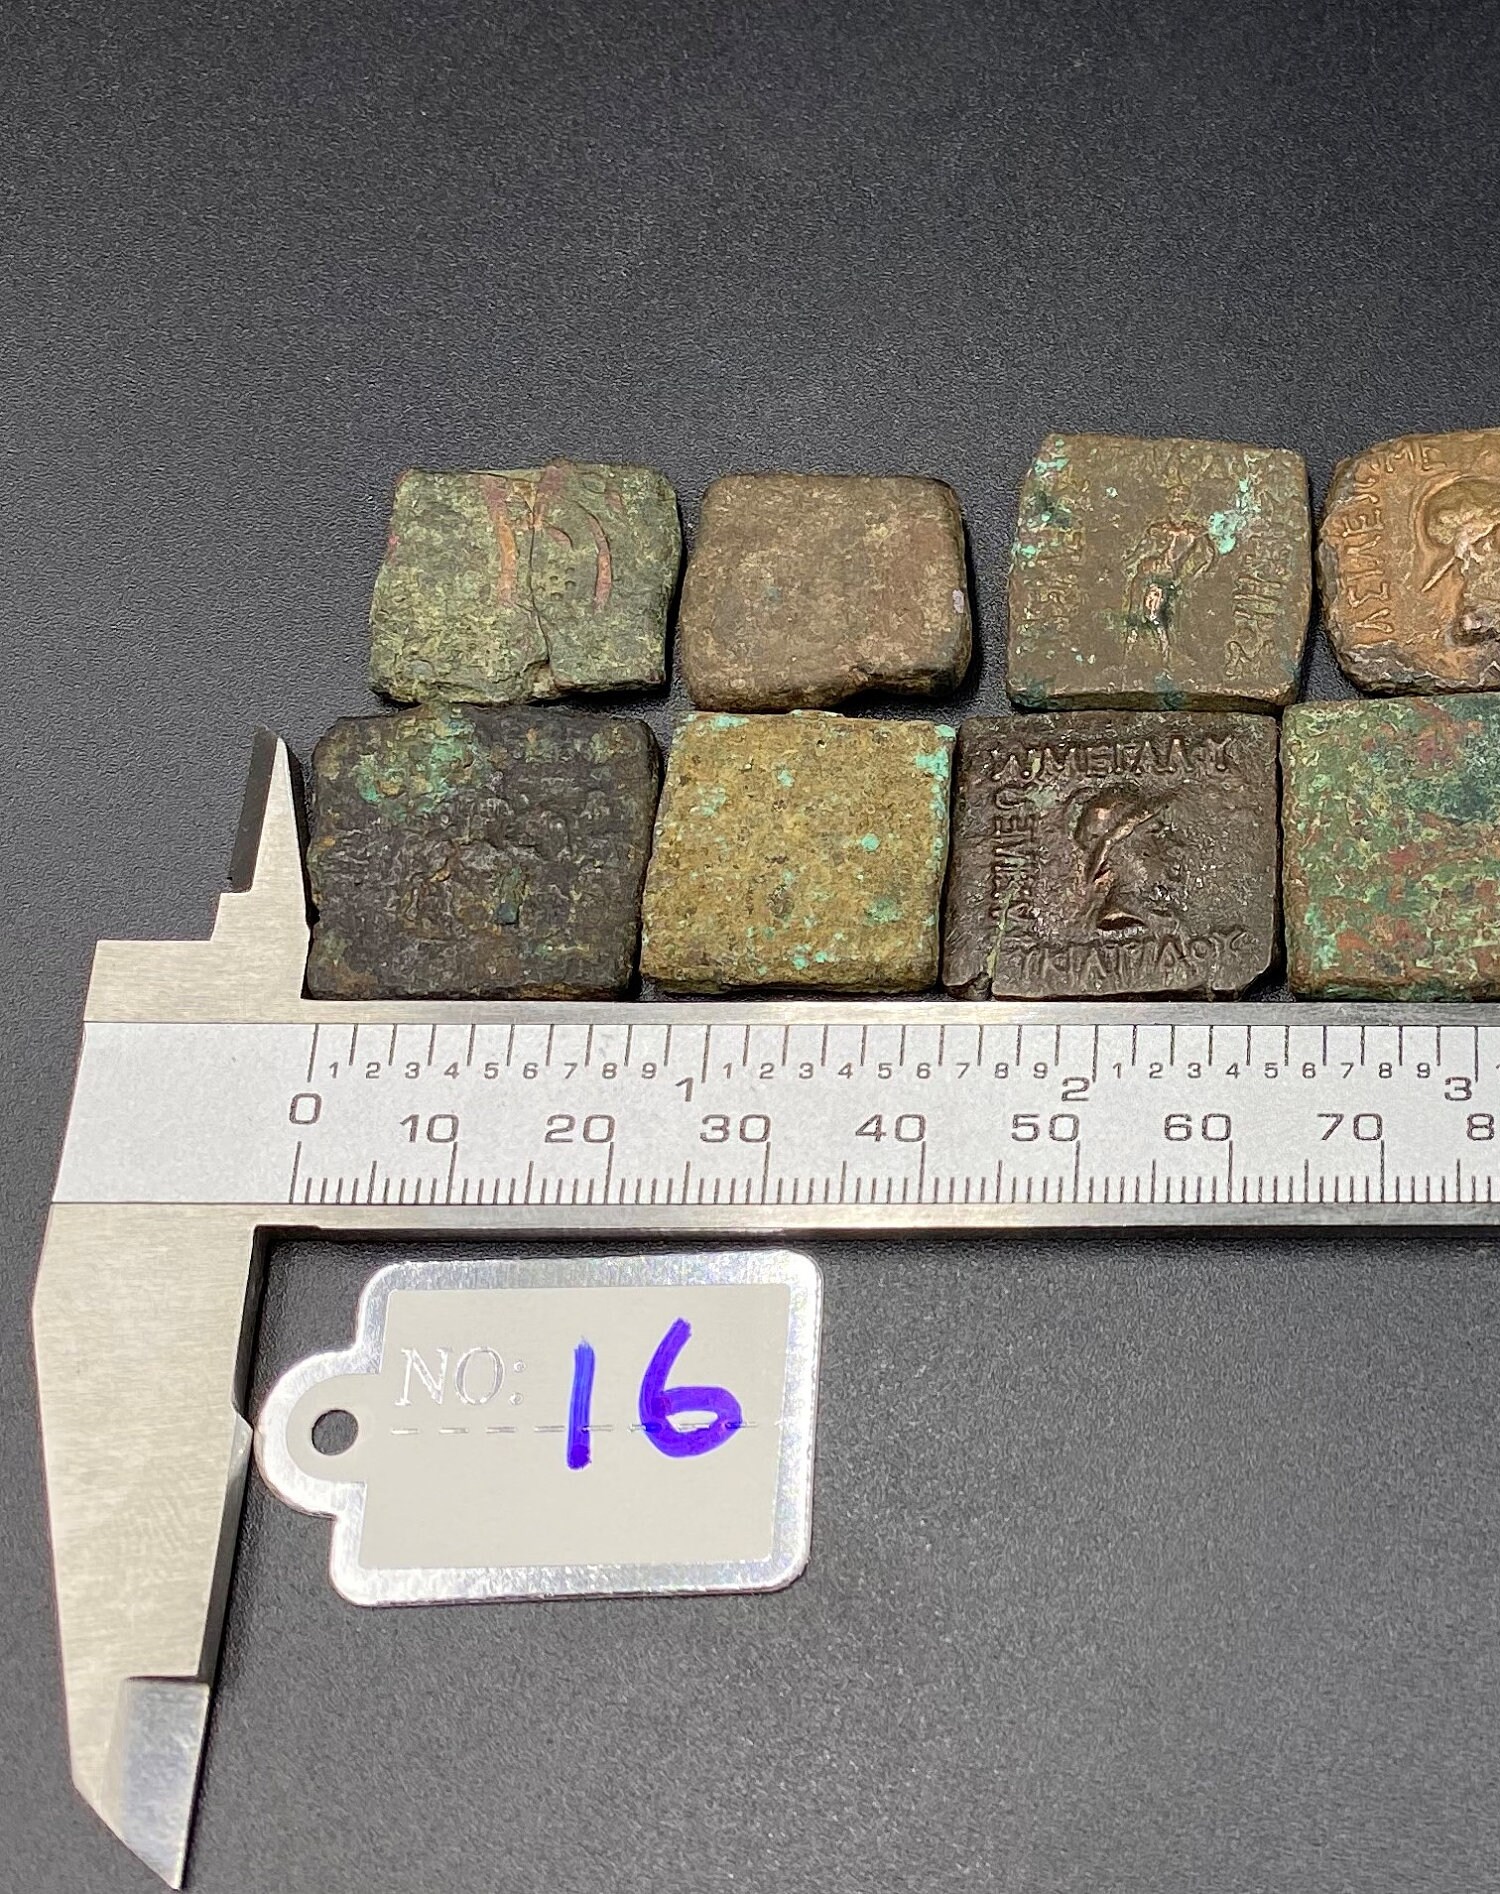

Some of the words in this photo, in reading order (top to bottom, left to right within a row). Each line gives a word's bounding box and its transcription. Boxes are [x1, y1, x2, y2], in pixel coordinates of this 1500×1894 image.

[328, 1060, 340, 1080] 1
[365, 1061, 382, 1080] 2
[404, 1061, 421, 1080] 3
[443, 1061, 461, 1080] 4
[483, 1061, 500, 1080] 5
[522, 1061, 539, 1080] 6
[562, 1061, 579, 1081] 7
[601, 1061, 618, 1080] 8
[640, 1061, 658, 1080] 9
[674, 1076, 695, 1103] 1
[722, 1061, 733, 1080] 1
[758, 1061, 776, 1080] 2
[798, 1061, 815, 1080] 3
[836, 1061, 854, 1080] 4
[877, 1061, 893, 1080] 5
[915, 1061, 932, 1080] 6
[954, 1061, 971, 1080] 7
[993, 1061, 1010, 1080] 8
[1032, 1061, 1049, 1080] 9
[1060, 1076, 1091, 1103] 2
[1112, 1061, 1123, 1080] 1
[1148, 1061, 1164, 1080] 2
[1186, 1061, 1202, 1080] 3
[1224, 1061, 1241, 1080] 4
[1263, 1061, 1279, 1080] 5
[1301, 1061, 1317, 1080] 6
[1339, 1061, 1355, 1080] 7
[1378, 1061, 1393, 1080] 8
[1415, 1061, 1432, 1080] 9
[1443, 1075, 1473, 1103] 3
[288, 1092, 323, 1126] 0
[398, 1113, 460, 1144] 10
[543, 1113, 616, 1144] 20
[699, 1113, 772, 1144] 30
[854, 1113, 927, 1143] 40
[1010, 1112, 1081, 1143] 50
[1163, 1112, 1232, 1142] 60
[1316, 1112, 1384, 1142] 70
[566, 1316, 743, 1470] 16
